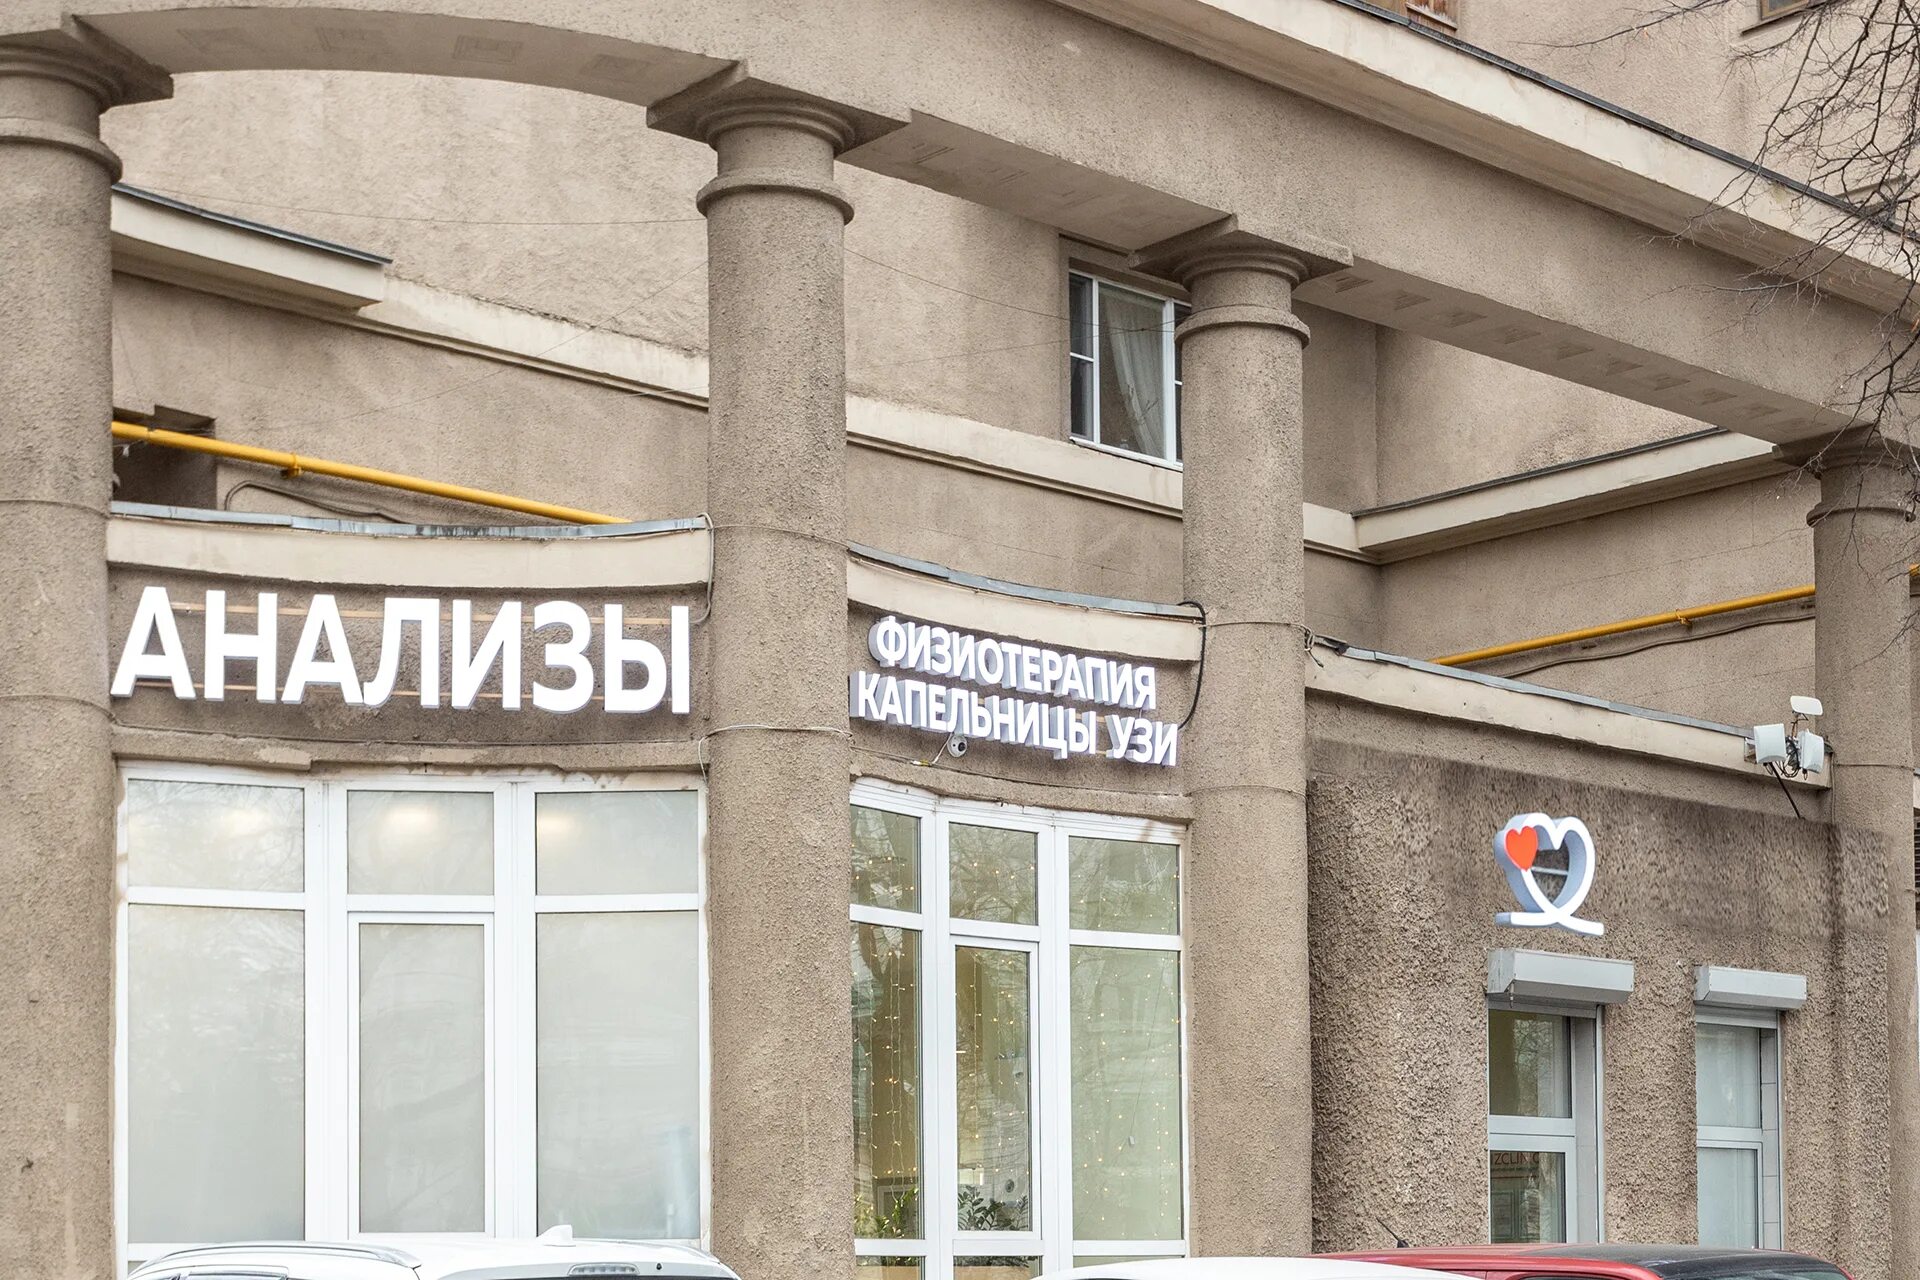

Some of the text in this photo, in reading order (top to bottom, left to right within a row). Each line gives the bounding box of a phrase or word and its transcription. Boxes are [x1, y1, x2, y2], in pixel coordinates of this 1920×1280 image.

[110, 586, 690, 713] АНАЛИЗЫ
[869, 616, 1157, 710] ФИЗИОТЕРАПИЯ
[851, 671, 1178, 767] КАПЕЛЬНИЦЫ УЗИ
